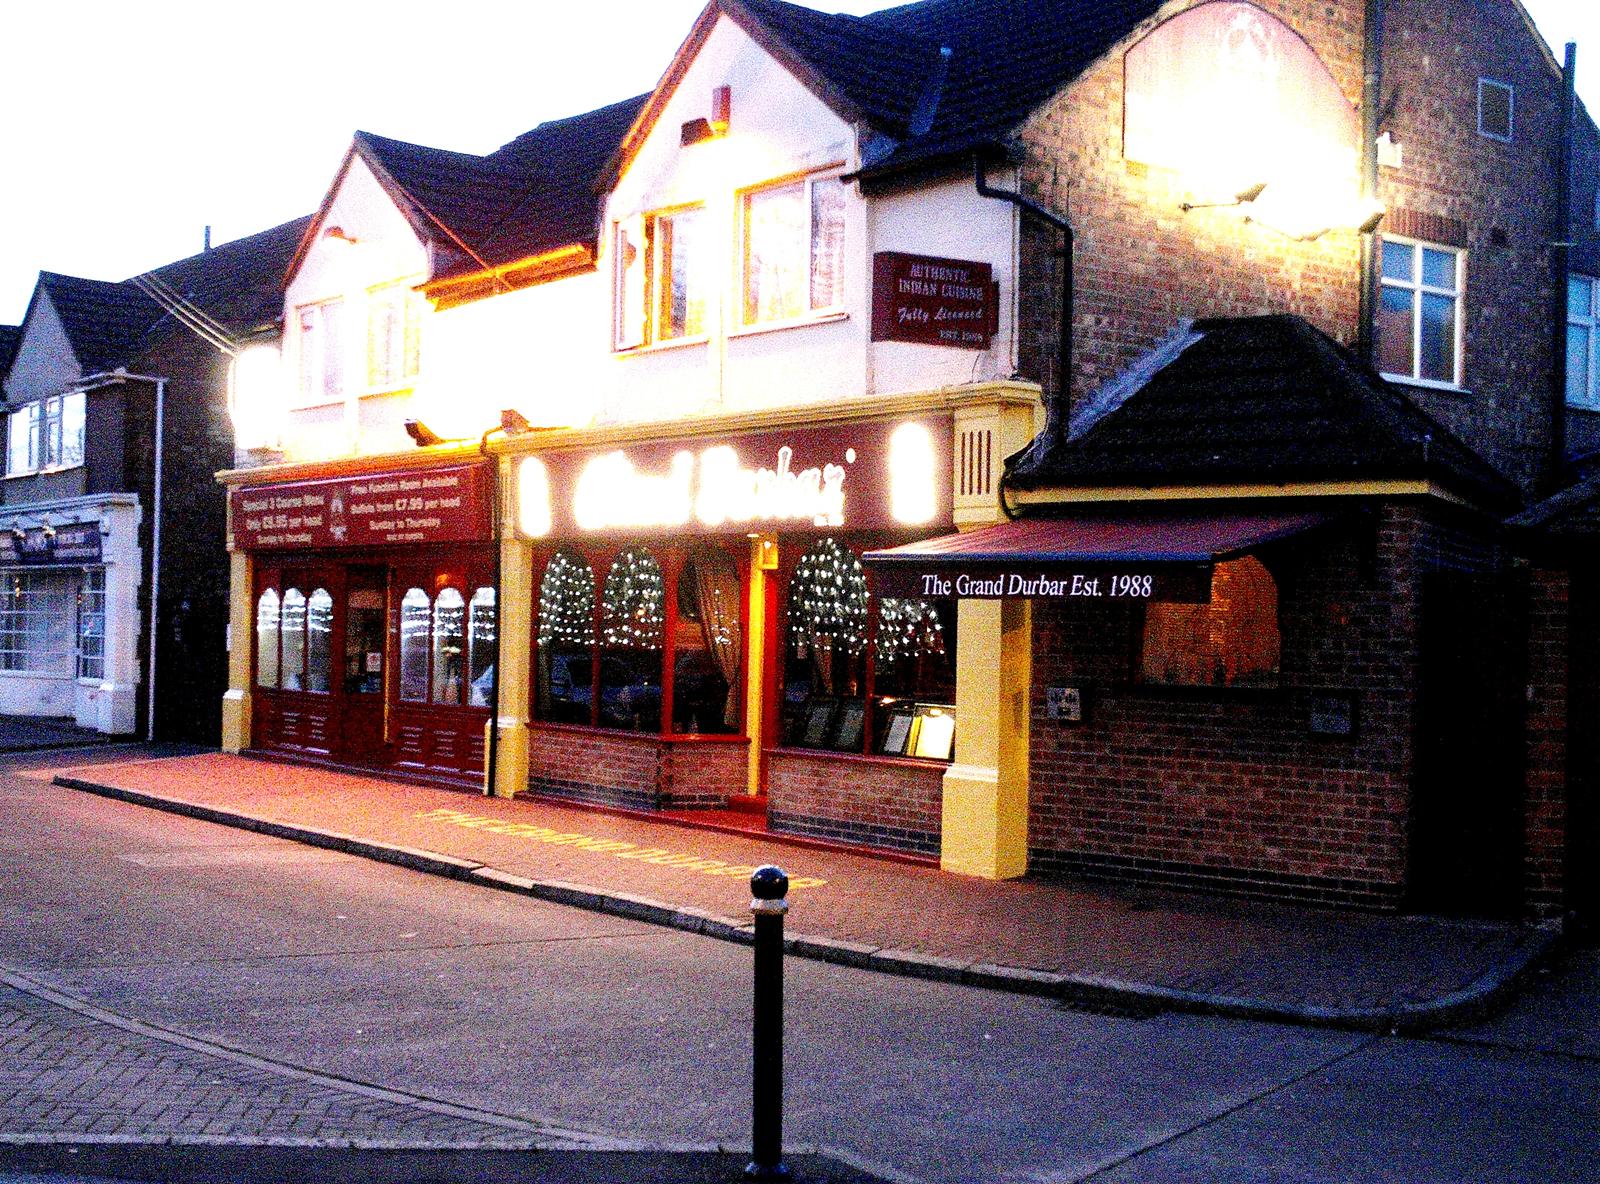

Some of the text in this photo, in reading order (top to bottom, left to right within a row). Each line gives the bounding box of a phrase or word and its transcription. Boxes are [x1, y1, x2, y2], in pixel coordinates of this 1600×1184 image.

[898, 278, 983, 301] INDIAN CUISINE
[921, 574, 1153, 597] The Grand Durbar Est. 1988
[614, 848, 828, 890] DURBR
